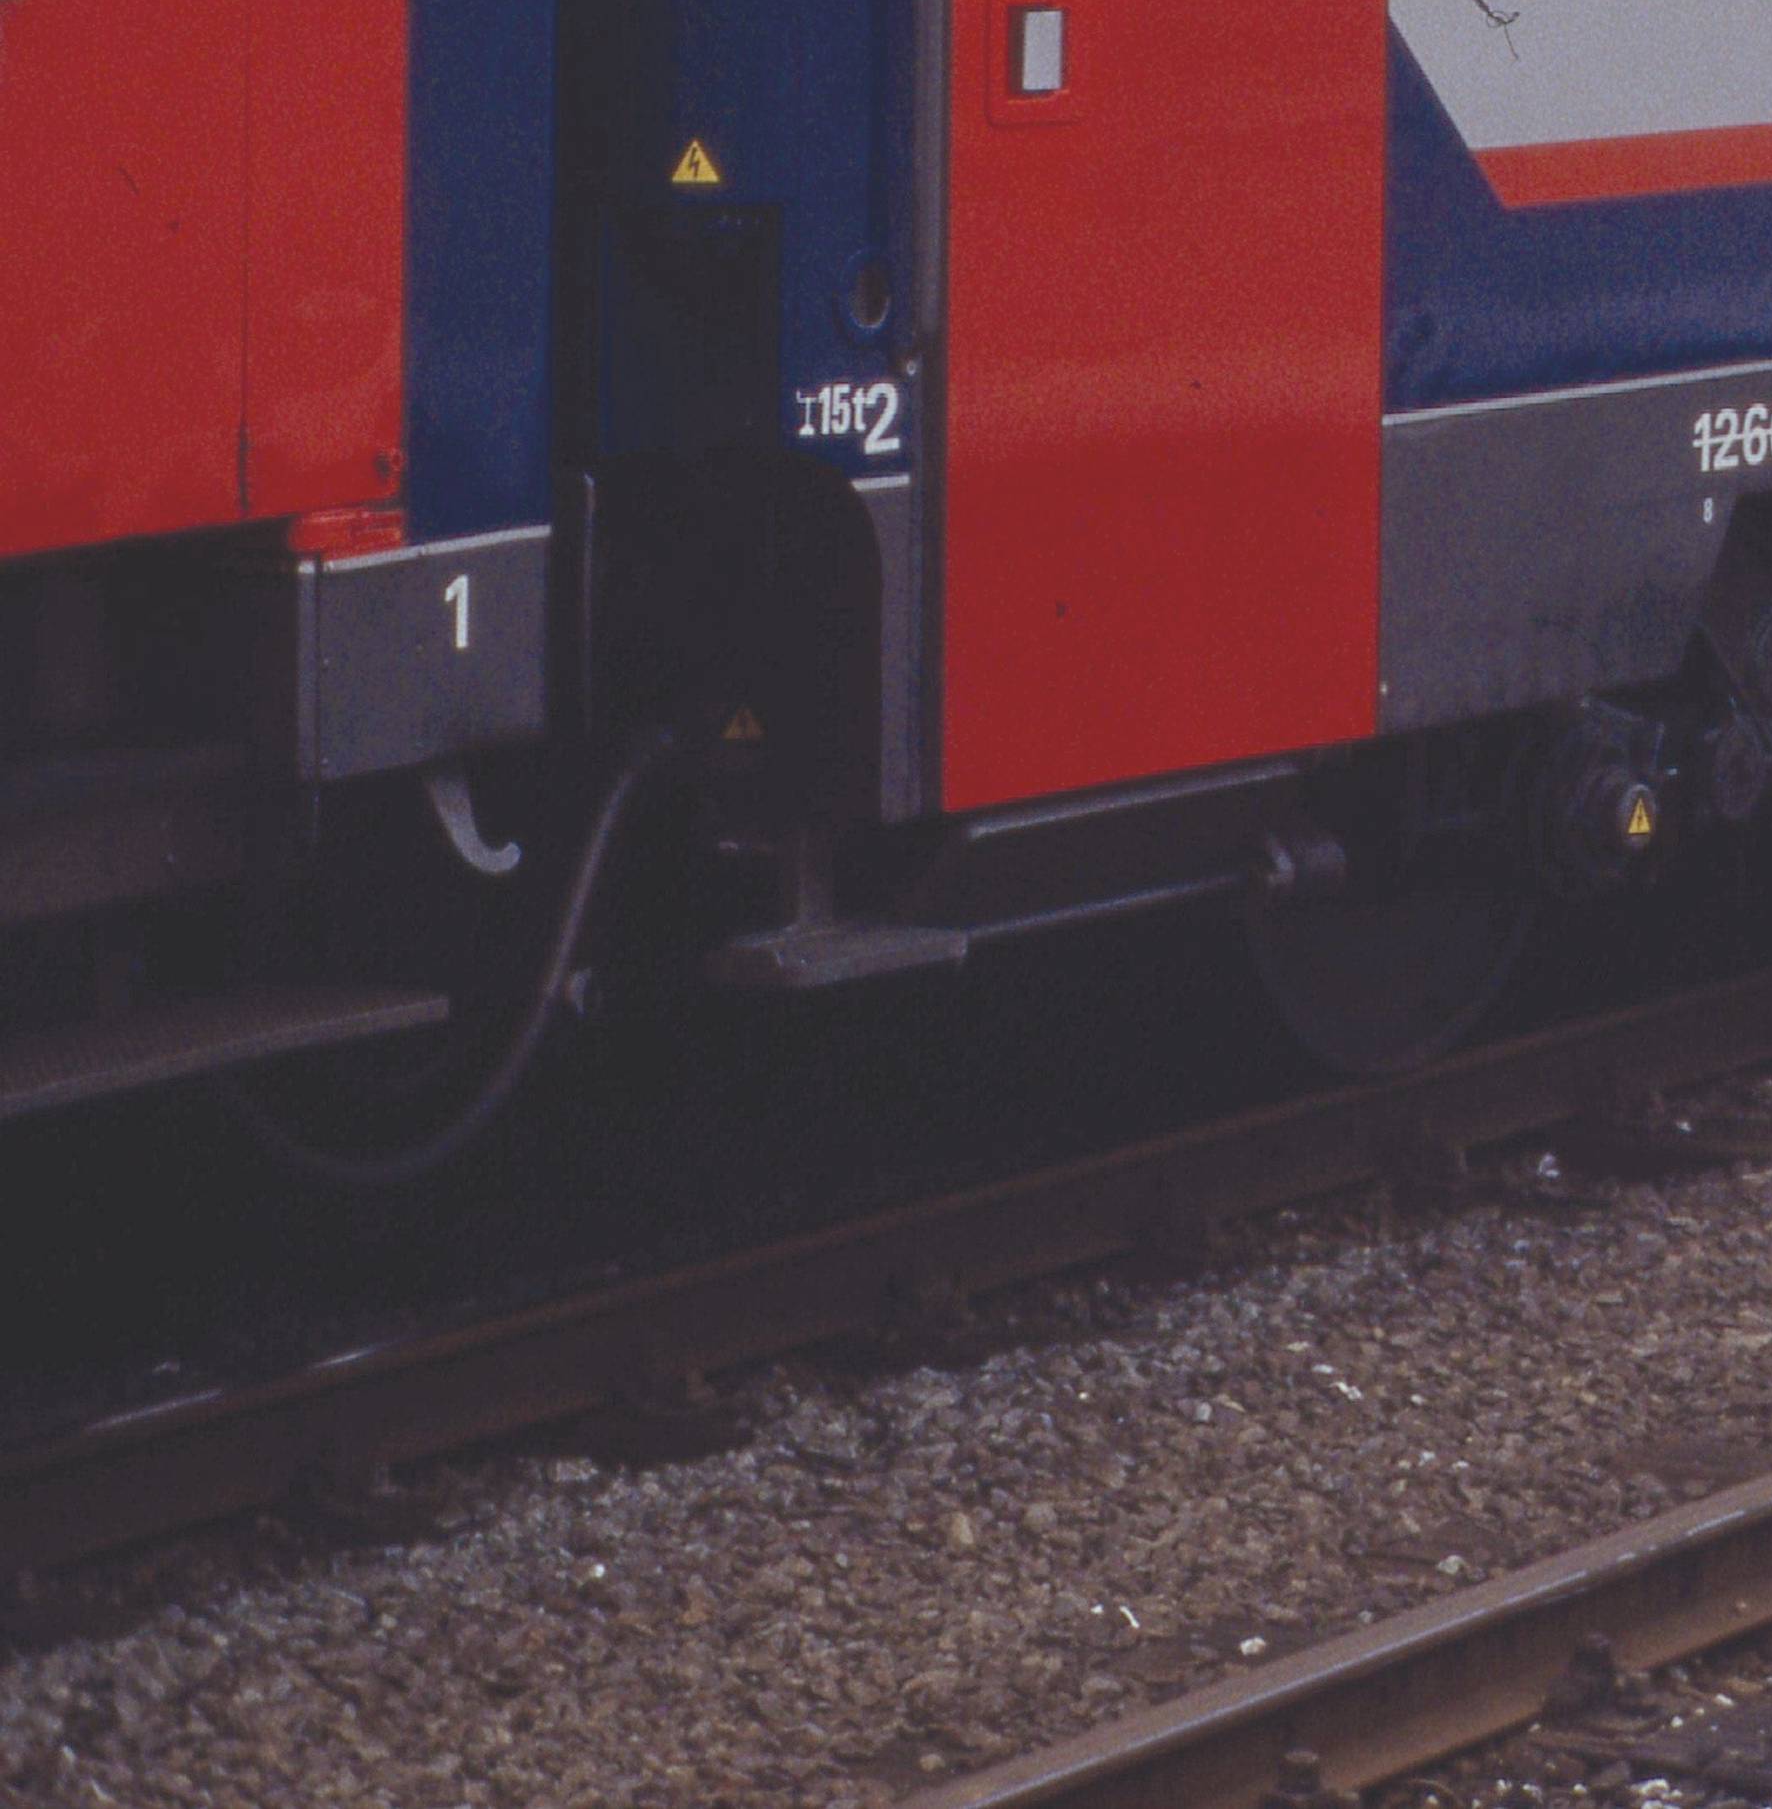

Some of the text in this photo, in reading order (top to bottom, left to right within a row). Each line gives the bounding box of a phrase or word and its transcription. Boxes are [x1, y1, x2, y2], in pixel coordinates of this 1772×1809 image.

[864, 382, 900, 455] 2
[1703, 497, 1713, 524] 8
[444, 573, 469, 648] 1
